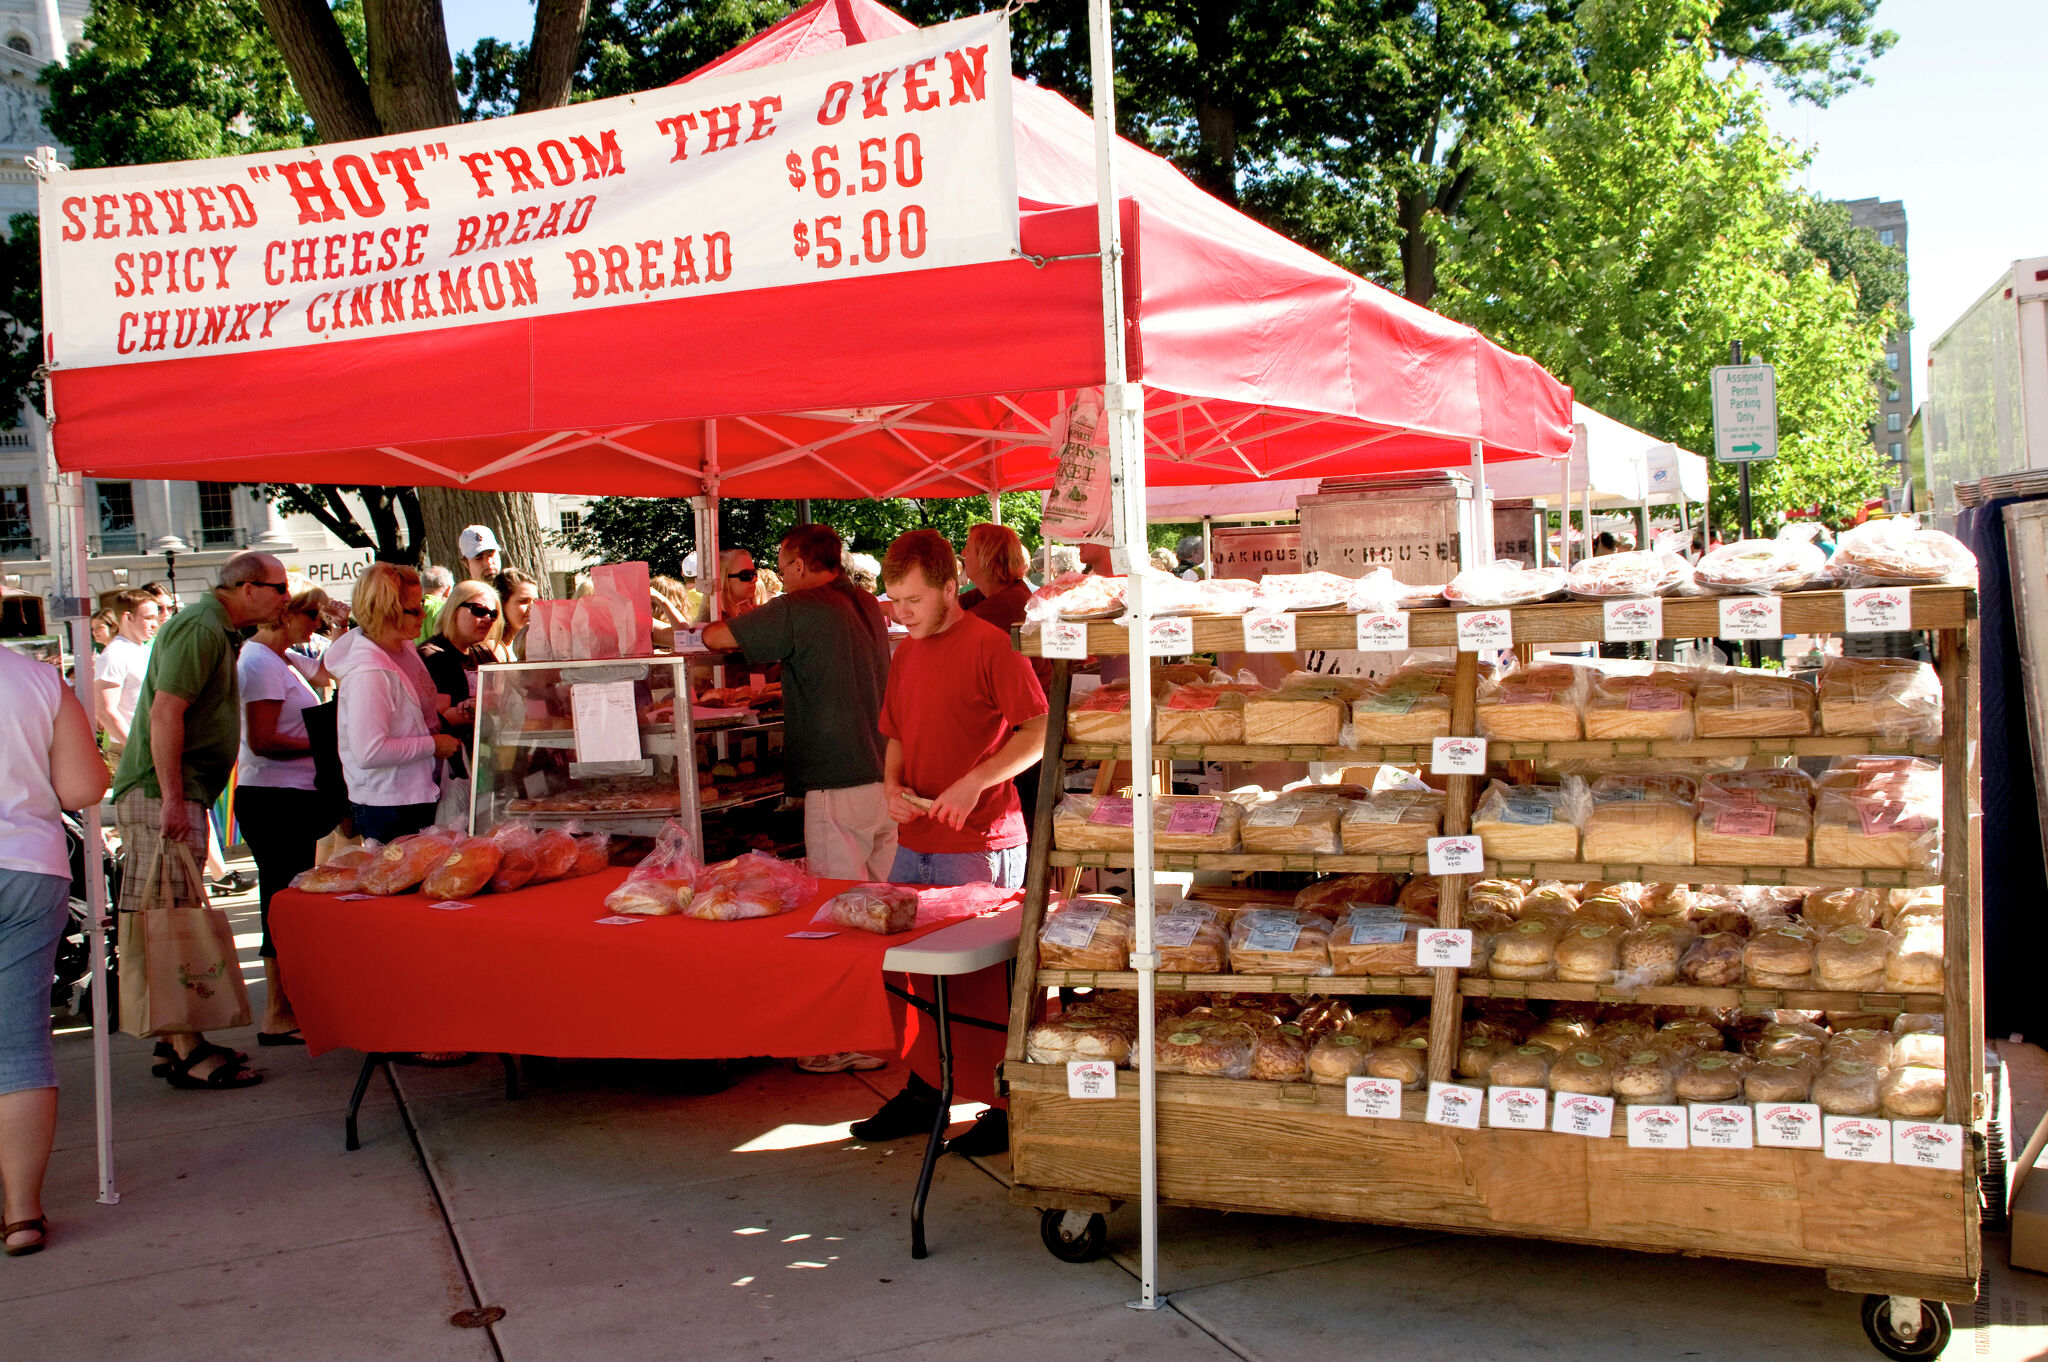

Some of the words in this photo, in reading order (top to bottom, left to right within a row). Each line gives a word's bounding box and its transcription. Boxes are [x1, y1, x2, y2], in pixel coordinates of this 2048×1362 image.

[61, 183, 258, 242] SERVED
[459, 128, 625, 198] FROM
[656, 95, 783, 164] THE
[817, 44, 989, 127] OVEN
[113, 244, 237, 299] SPICY
[263, 223, 430, 286] CHEESE
[449, 194, 597, 257] BREAD
[785, 132, 924, 199] $6.50
[116, 298, 290, 355] CHUNKY
[305, 256, 540, 333] CINNAMON
[564, 231, 732, 300] BREAD
[793, 204, 928, 269] $5.00
[1727, 372, 1763, 384] Assigned
[1731, 386, 1758, 396] Permit
[1730, 399, 1760, 411] Parking
[1737, 412, 1755, 424] Only
[308, 562, 363, 582] PFLAG
